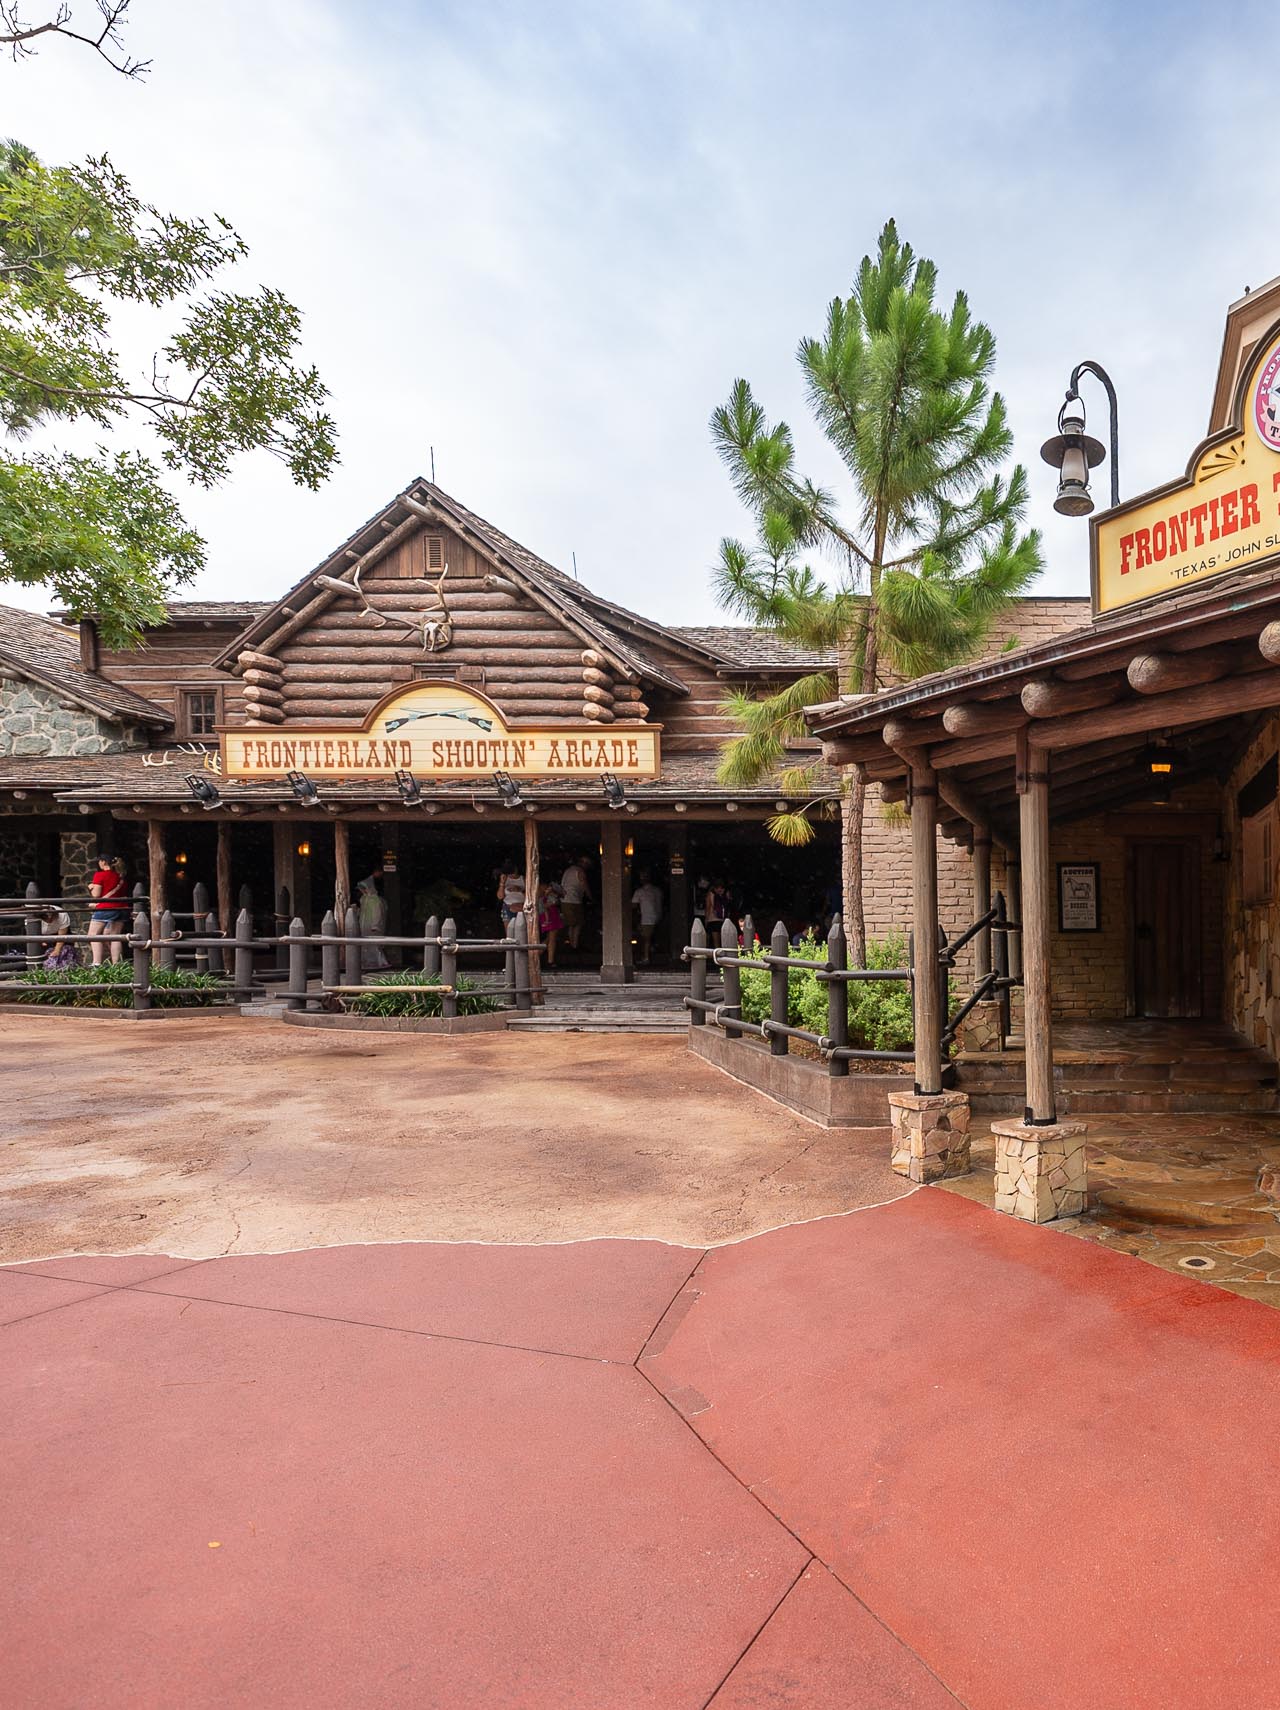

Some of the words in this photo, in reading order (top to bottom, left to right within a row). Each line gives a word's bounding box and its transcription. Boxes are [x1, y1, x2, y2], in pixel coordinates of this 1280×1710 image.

[1119, 483, 1261, 576] FRONTIER
[1224, 540, 1261, 563] JOHN
[242, 741, 412, 768] FRONTIERLAND
[547, 739, 639, 768] ARCADE
